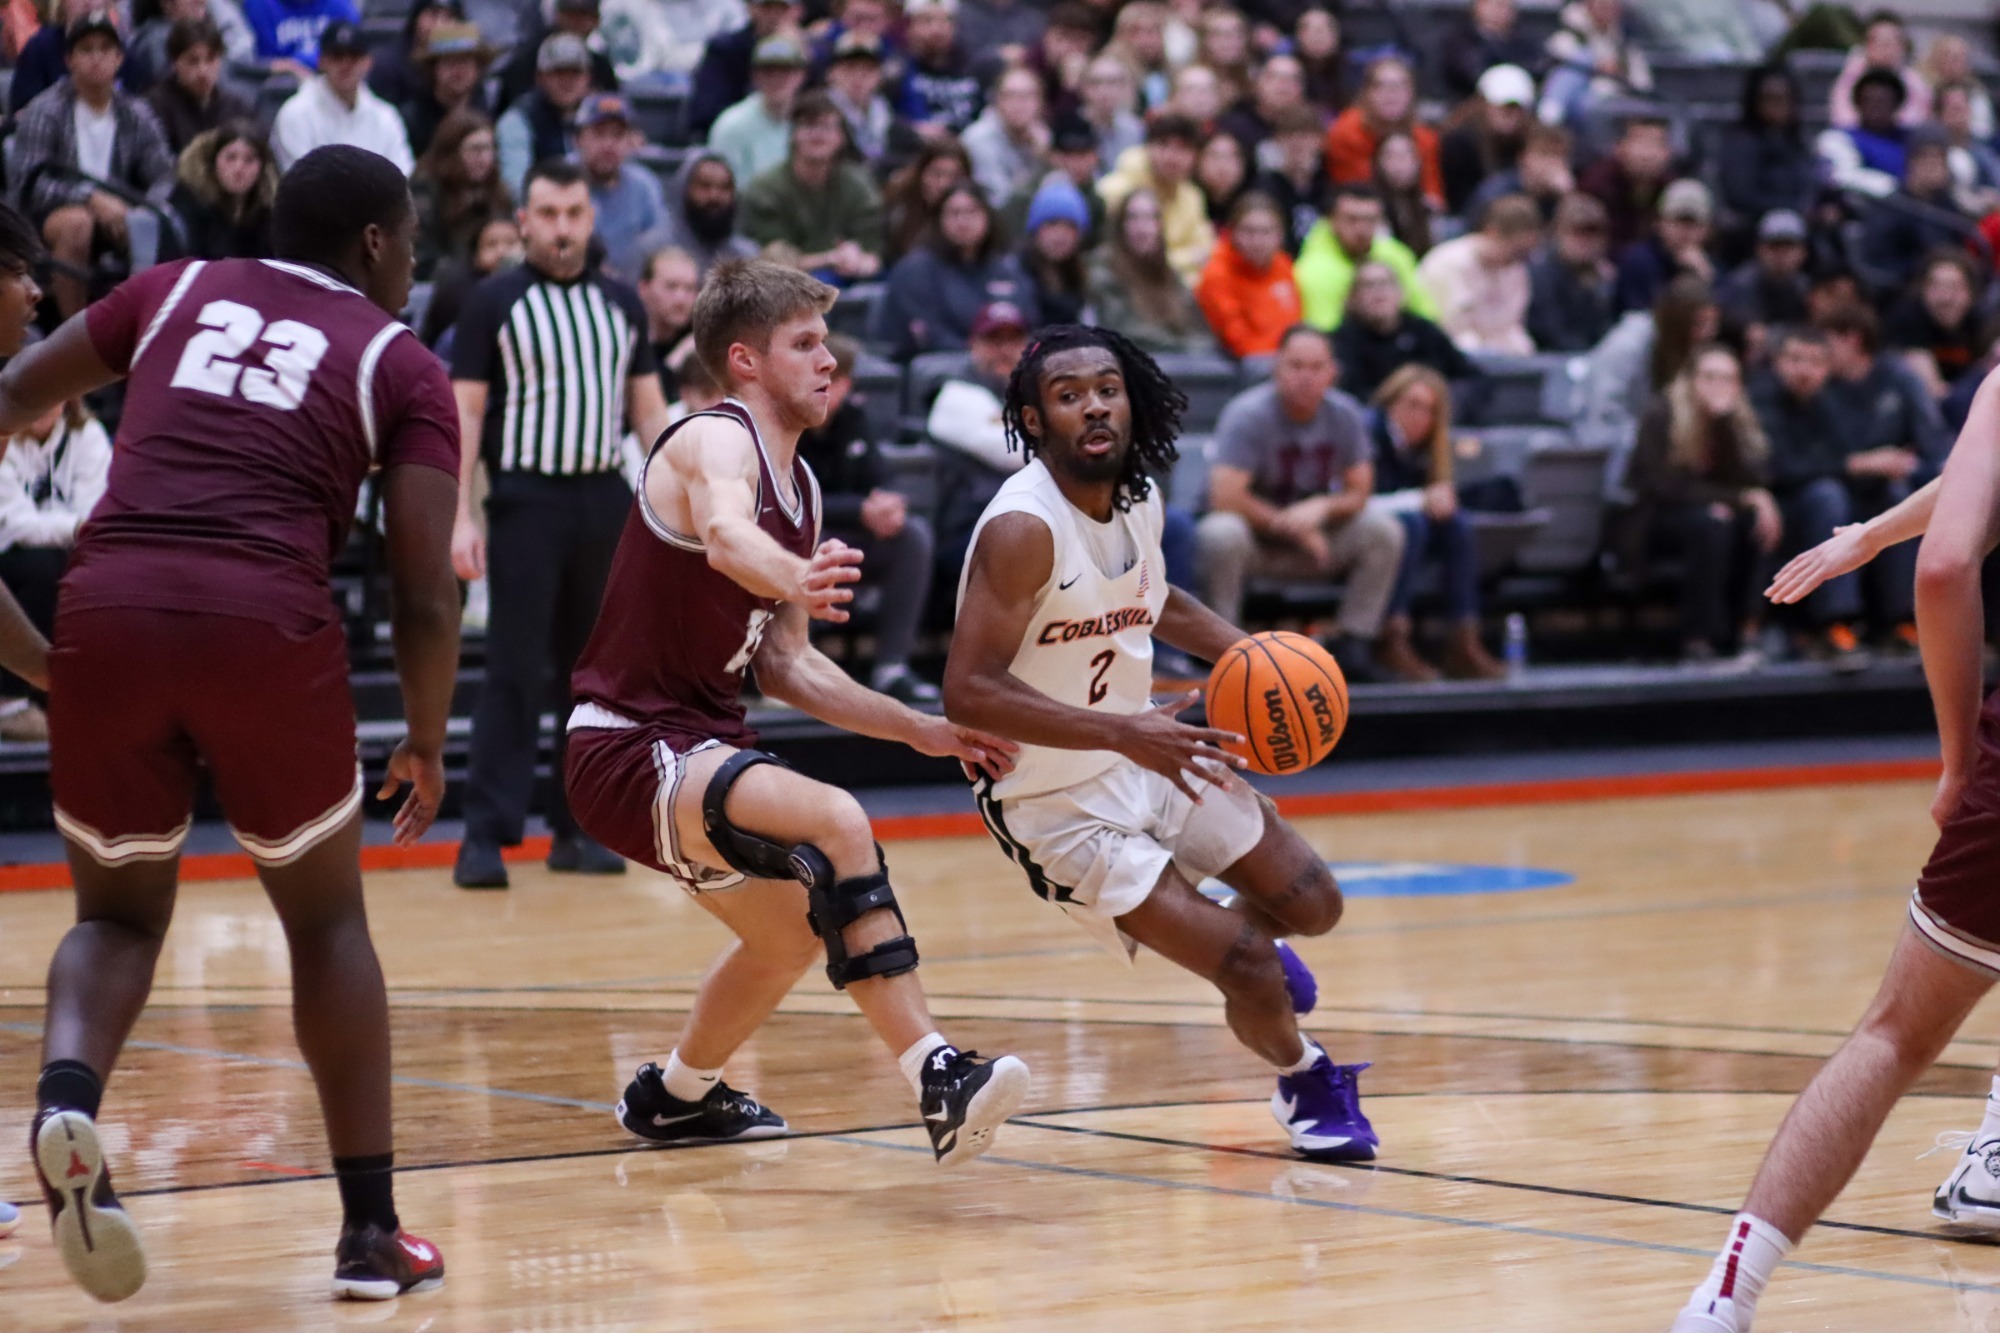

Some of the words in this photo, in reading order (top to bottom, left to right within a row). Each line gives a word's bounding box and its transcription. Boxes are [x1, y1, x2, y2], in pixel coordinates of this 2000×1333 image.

[169, 299, 331, 411] 23
[1088, 649, 1117, 706] 2
[1304, 682, 1336, 746] NCAA
[1263, 685, 1303, 771] Wilson
